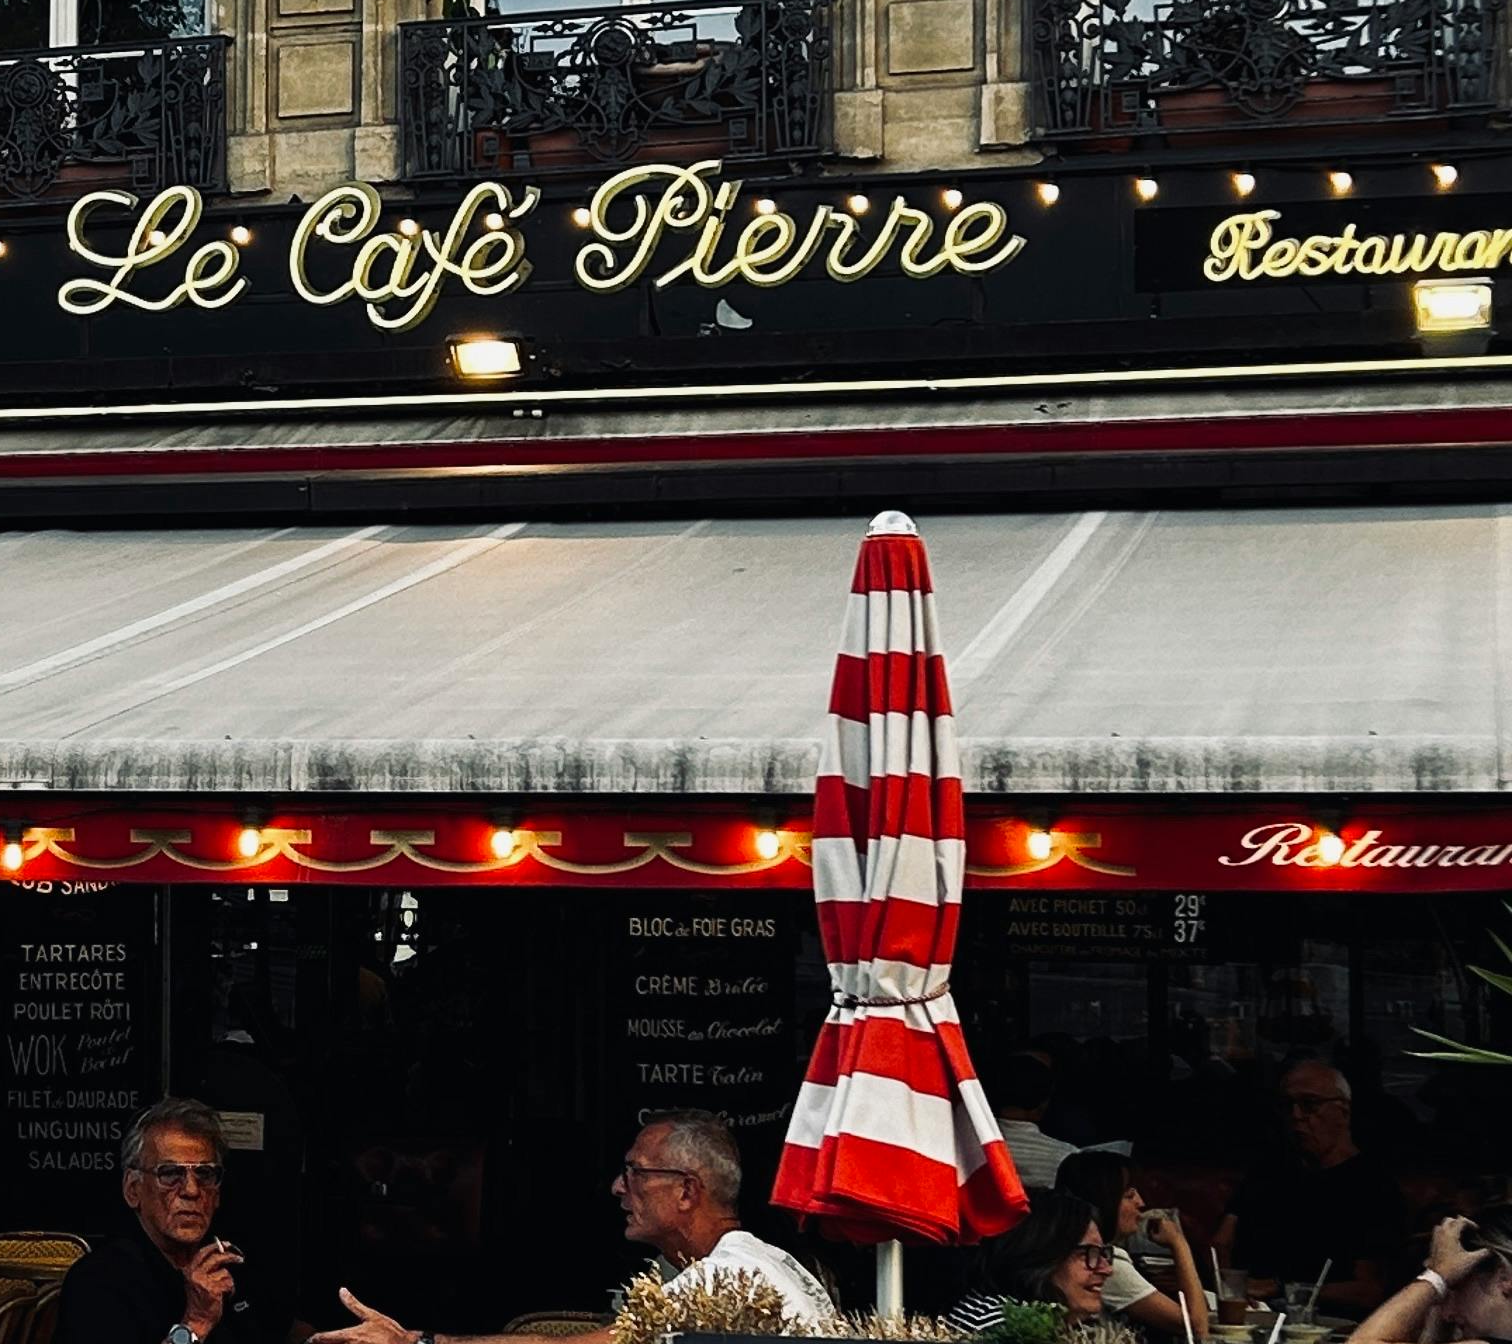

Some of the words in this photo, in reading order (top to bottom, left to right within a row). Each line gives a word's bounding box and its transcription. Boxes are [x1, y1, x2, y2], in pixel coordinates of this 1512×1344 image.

[57, 184, 252, 316] Le
[288, 180, 542, 335] Café
[573, 157, 1030, 294] Pierre
[628, 916, 675, 938] BLOC
[691, 917, 728, 937] FOIE
[730, 917, 777, 938] GRAS
[20, 943, 128, 964] TARTARES
[18, 969, 126, 992] ENTRECÔTE
[13, 1002, 84, 1022] POULET
[90, 997, 132, 1022] RÔTI
[626, 1018, 687, 1040] MOUSSE
[7, 1033, 70, 1077] WOK
[636, 1062, 705, 1085] TARTE
[7, 1089, 53, 1110] FILET
[65, 1090, 140, 1110] DAURADE
[17, 1121, 123, 1141] LINGUINIS
[27, 1151, 116, 1171] SALADES
